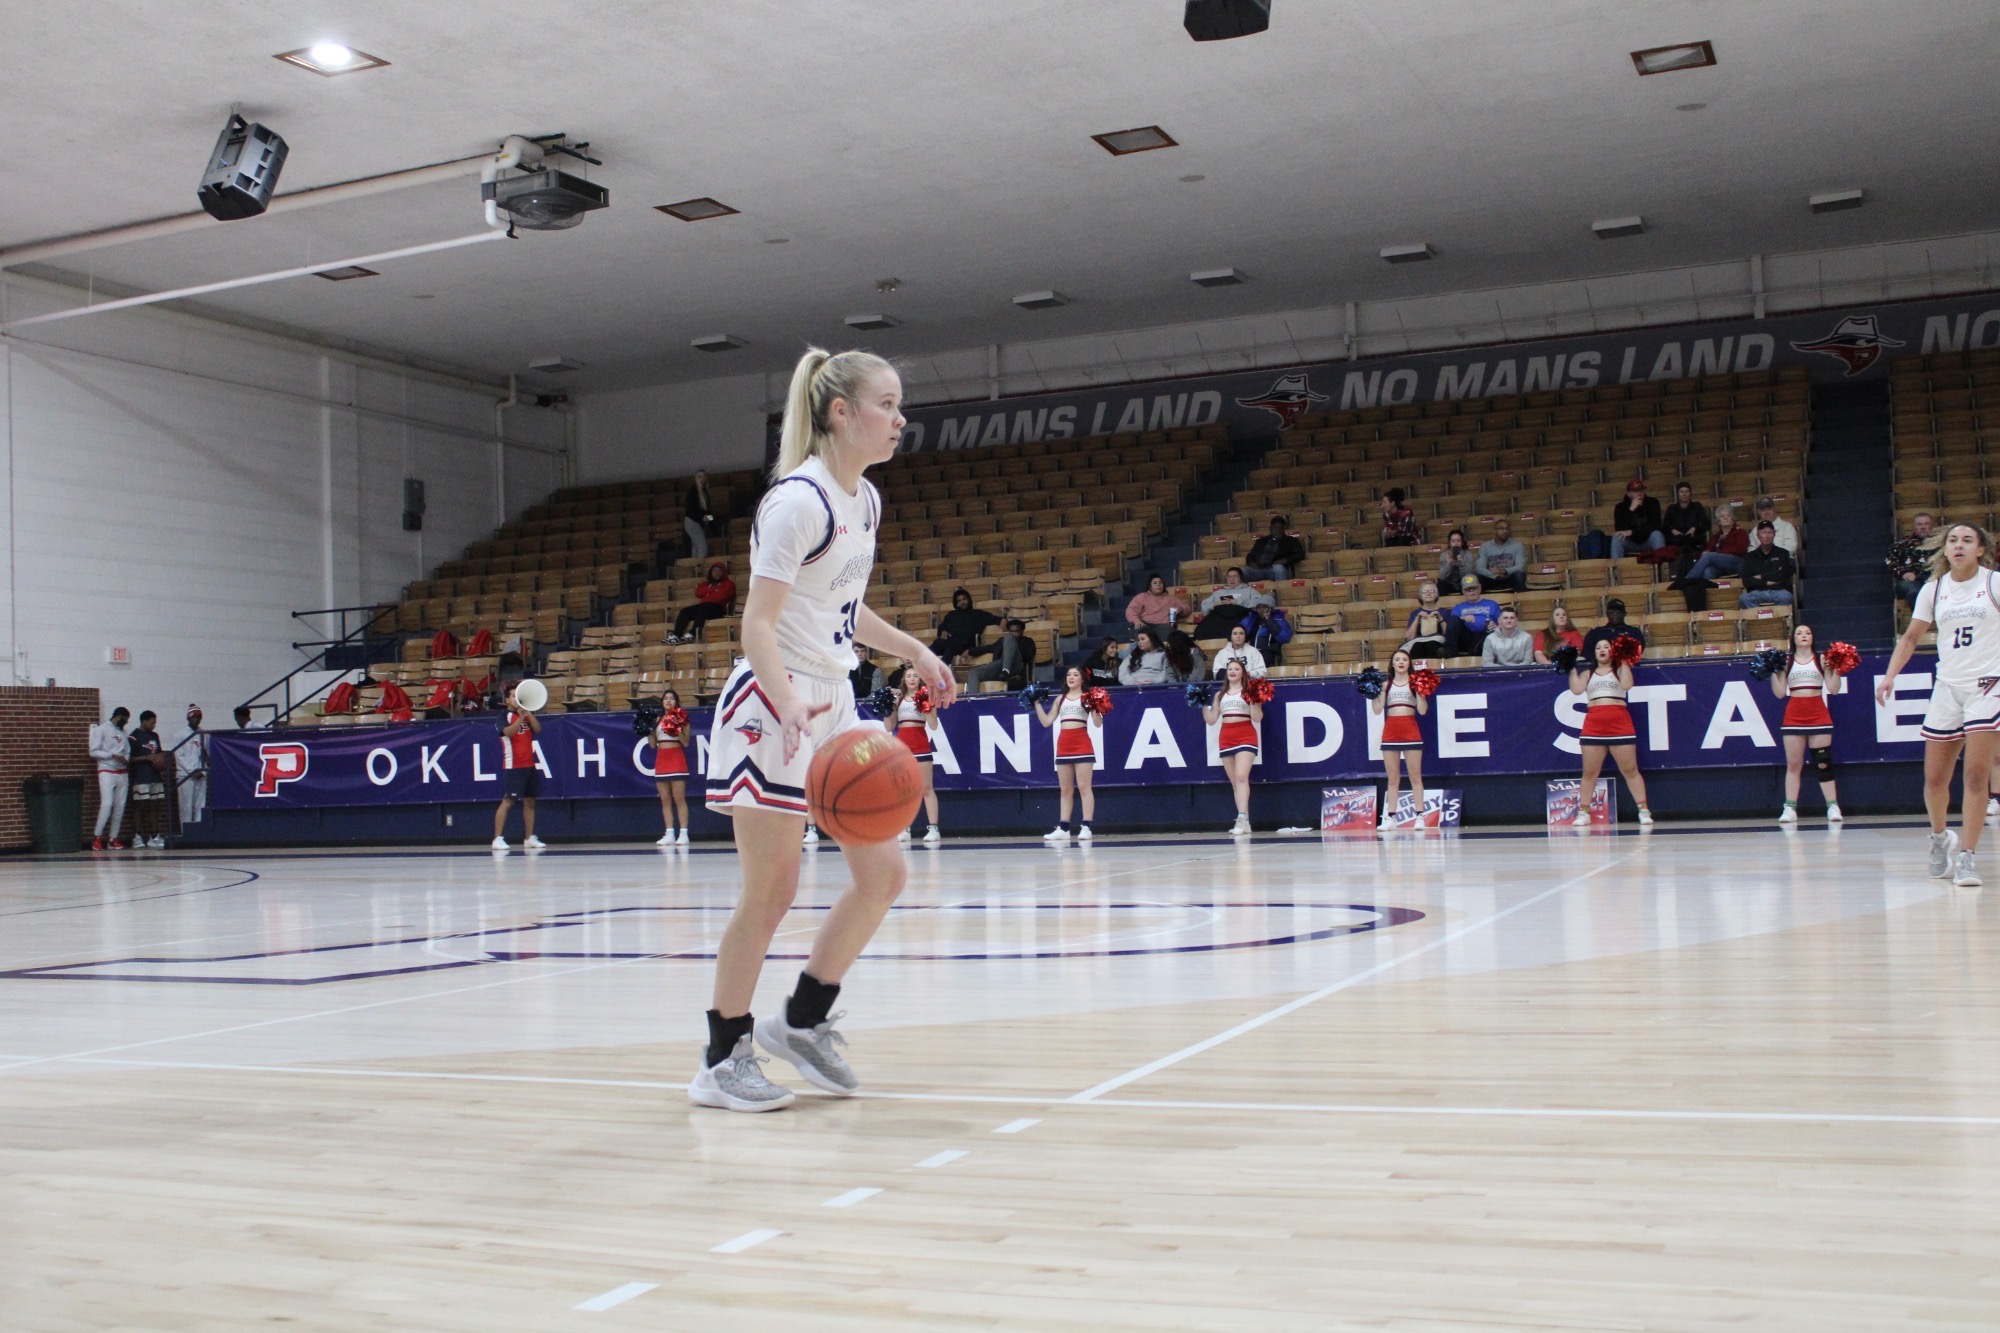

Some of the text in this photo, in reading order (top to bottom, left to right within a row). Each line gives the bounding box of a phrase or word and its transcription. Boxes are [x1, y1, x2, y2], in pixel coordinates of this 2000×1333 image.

[1920, 309, 2000, 356] NO
[1340, 333, 1775, 410] NO MANS LAND
[937, 405, 1078, 451] MANS
[1090, 390, 1223, 437] LAND
[113, 648, 127, 661] EXIT
[1953, 626, 1973, 648] 15
